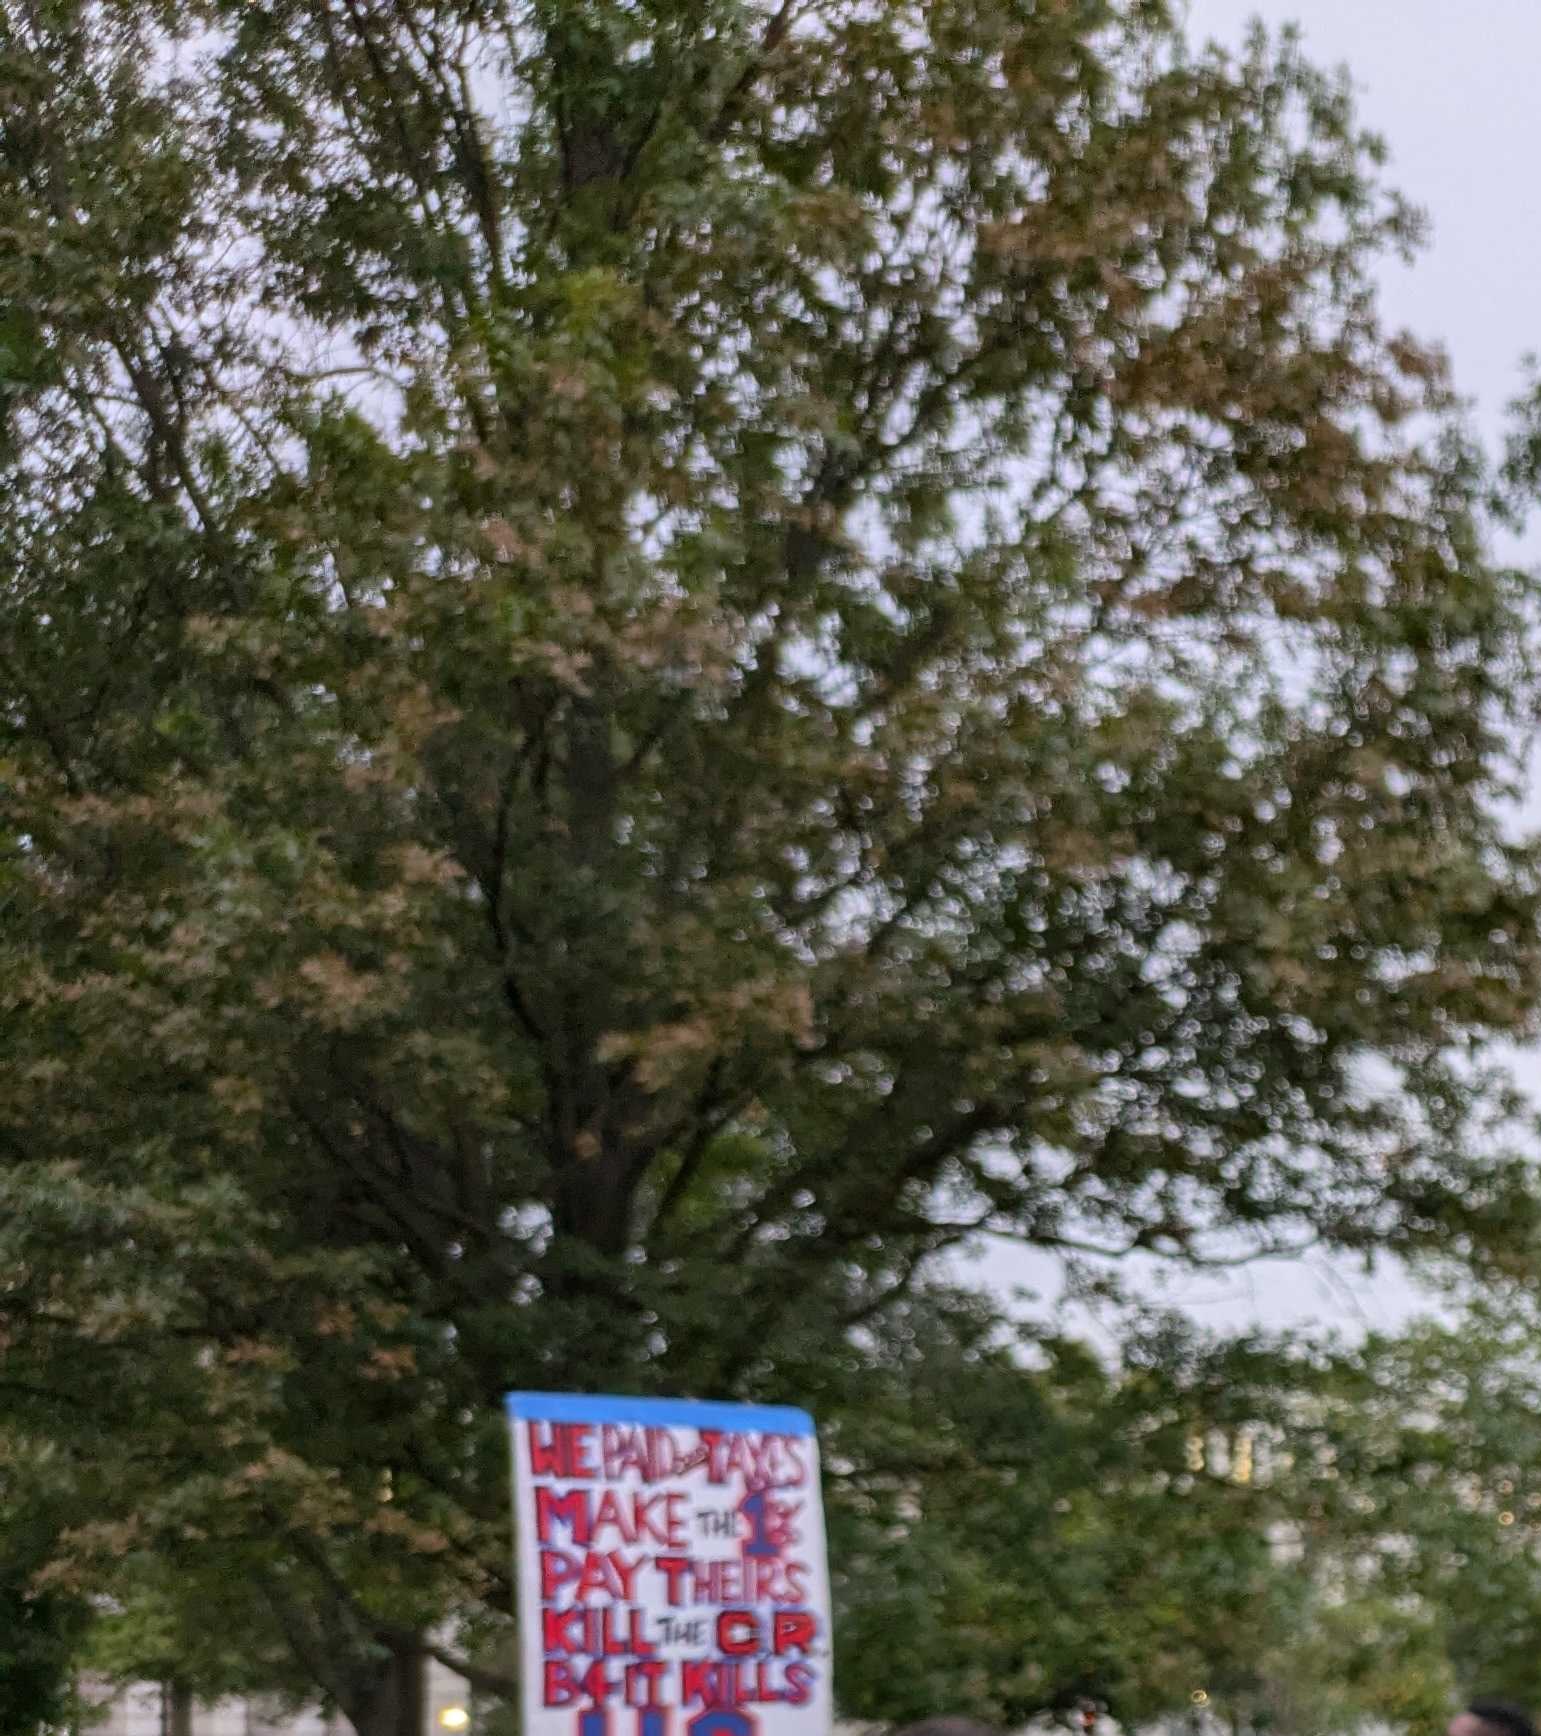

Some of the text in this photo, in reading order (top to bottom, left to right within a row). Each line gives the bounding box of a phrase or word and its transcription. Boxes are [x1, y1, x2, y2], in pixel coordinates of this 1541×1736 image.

[528, 1421, 596, 1478] WE
[533, 1486, 689, 1549] MAKE
[696, 1511, 742, 1540] THE
[539, 1550, 811, 1606] PAY THEIRS
[541, 1607, 657, 1656] KILL
[656, 1614, 706, 1648] THE
[682, 1660, 816, 1709] KILLS
